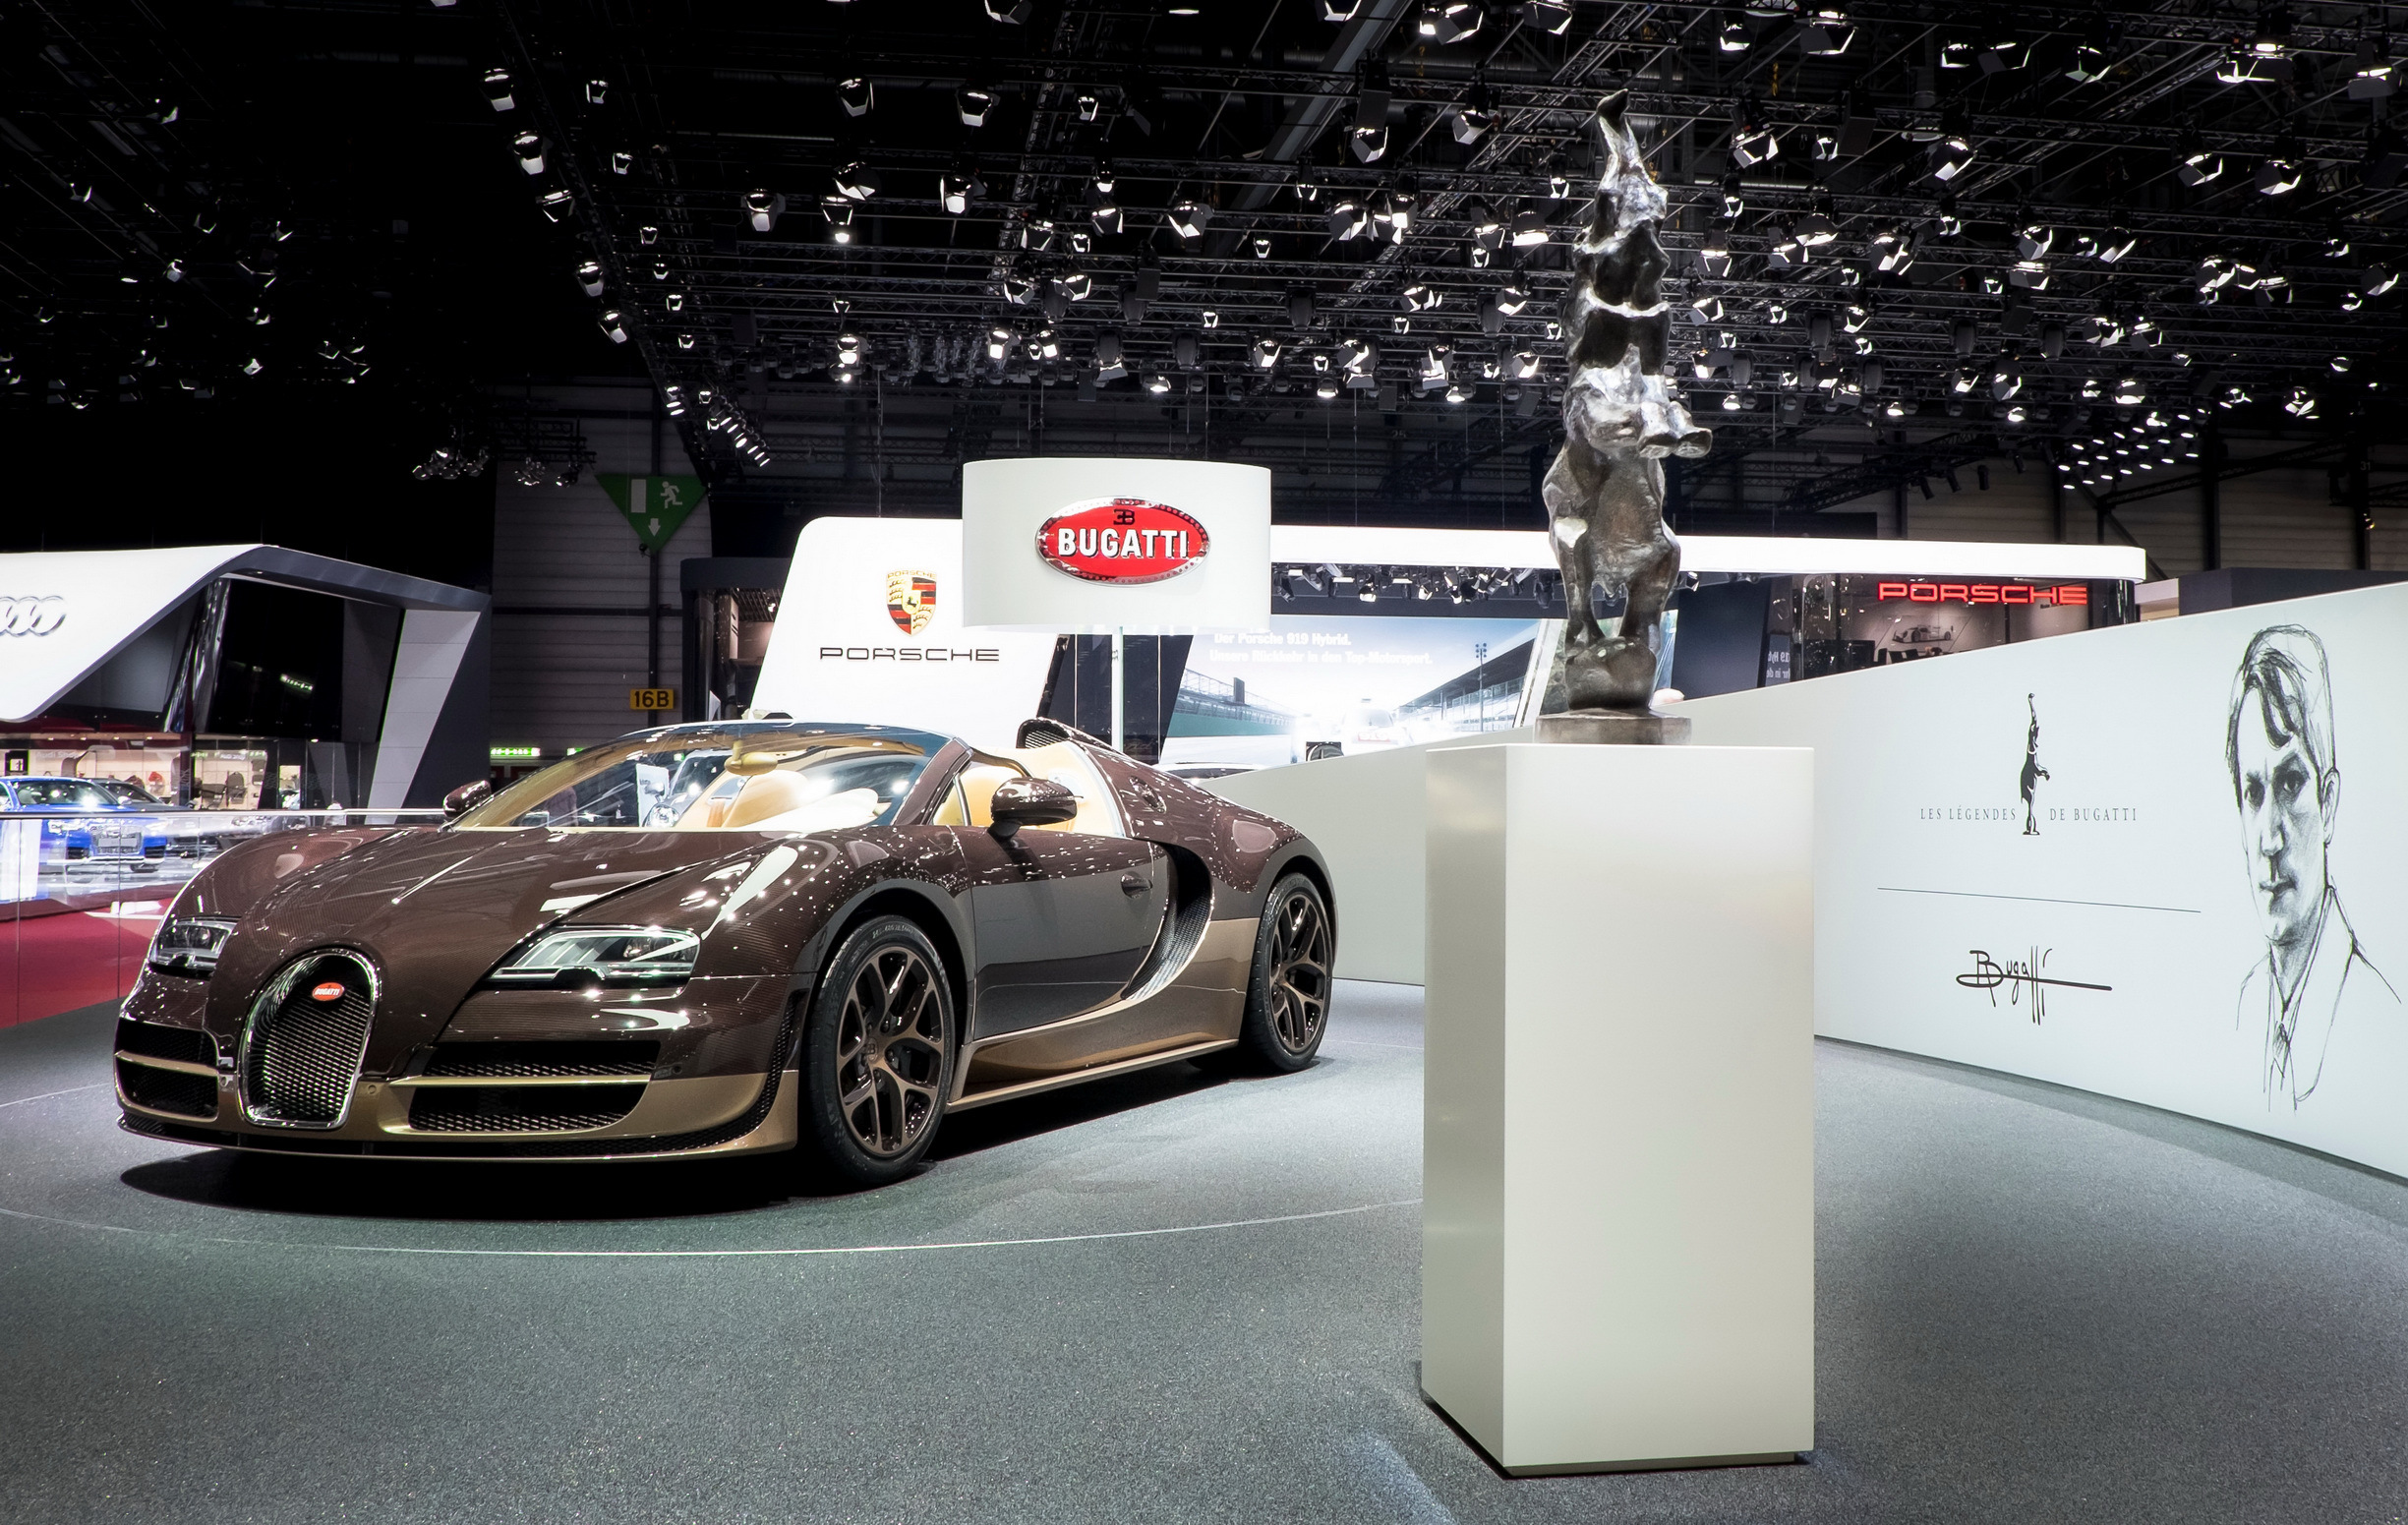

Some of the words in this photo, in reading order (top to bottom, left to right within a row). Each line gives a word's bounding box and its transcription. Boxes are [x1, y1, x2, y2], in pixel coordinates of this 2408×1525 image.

[2360, 461, 2371, 471] 31
[1058, 527, 1189, 558] BUGATTI
[1878, 582, 2087, 605] PORSCHE
[1214, 632, 1235, 644] Der
[1238, 632, 1283, 645] Porsche
[1286, 632, 1309, 645] 919
[1312, 632, 1352, 647] Hybrid.
[820, 647, 1000, 661] PORSCHE
[1209, 649, 1249, 662] Unsere
[1252, 649, 1305, 663] Rückkehr
[1307, 650, 1318, 663] in
[1321, 650, 1342, 663] den
[1344, 651, 1433, 667] Top-Motorsport.
[634, 690, 670, 708] 16B
[1920, 808, 1943, 820] LES
[1949, 805, 2017, 820] LÉGENDES
[2049, 807, 2066, 821] DE
[2074, 807, 2137, 821] BUGATTI
